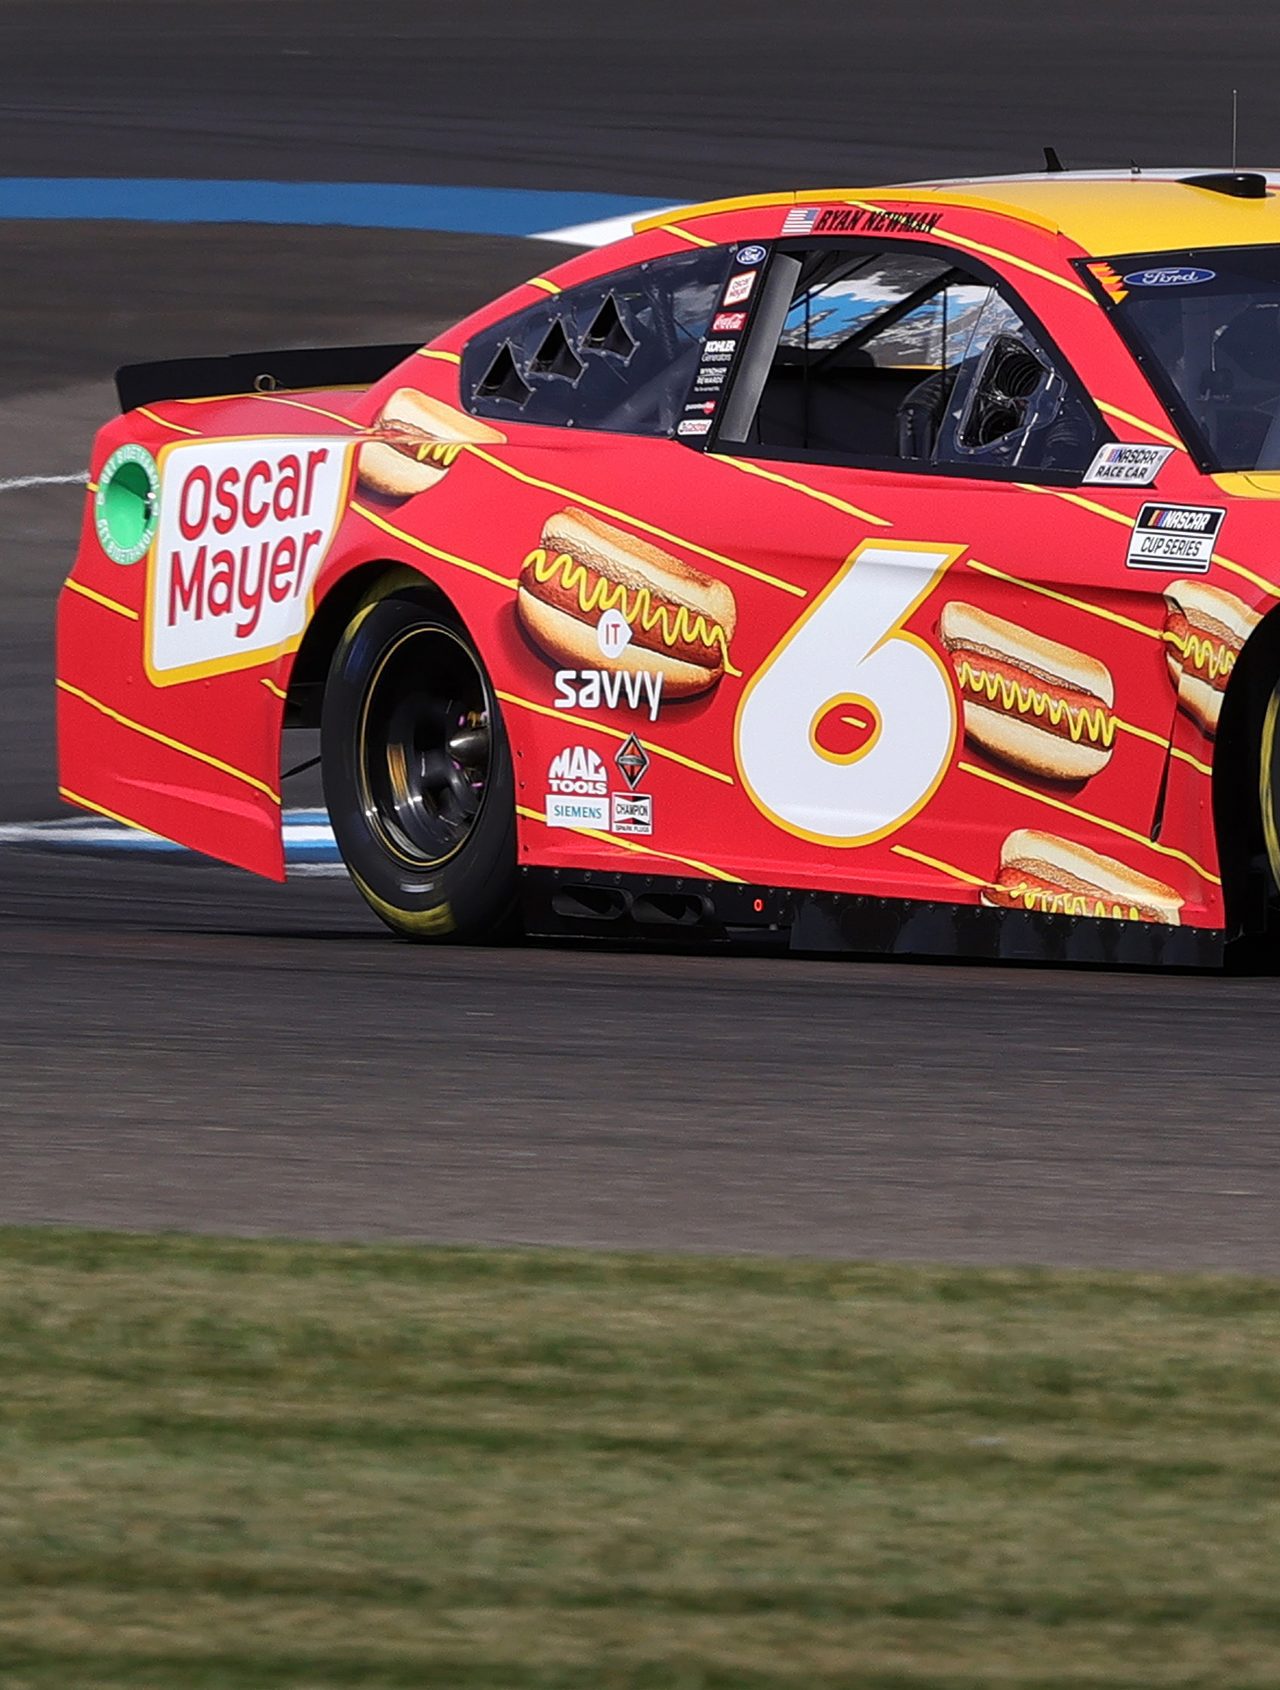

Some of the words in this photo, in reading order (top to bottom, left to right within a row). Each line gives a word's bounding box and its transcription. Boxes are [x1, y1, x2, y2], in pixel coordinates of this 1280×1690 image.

[814, 210, 865, 232] RYAN
[864, 211, 944, 234] NEWMAN
[1142, 269, 1199, 284] Ford
[704, 340, 737, 352] KOHLER
[1115, 449, 1159, 465] NASCAR
[1095, 465, 1123, 478] RACE
[1124, 466, 1149, 479] CAR
[179, 448, 329, 541] Oscar
[1162, 510, 1212, 531] NASCAR
[1140, 537, 1164, 553] CUP
[1163, 540, 1203, 557] SERIES
[168, 529, 323, 638] Mayer
[605, 623, 621, 645] IT
[554, 670, 664, 722] savvy
[735, 538, 969, 847] 6
[548, 745, 608, 782] MAC
[548, 779, 608, 795] TOOLS
[553, 804, 602, 819] SIEMENS
[615, 803, 648, 816] CHAMPION
